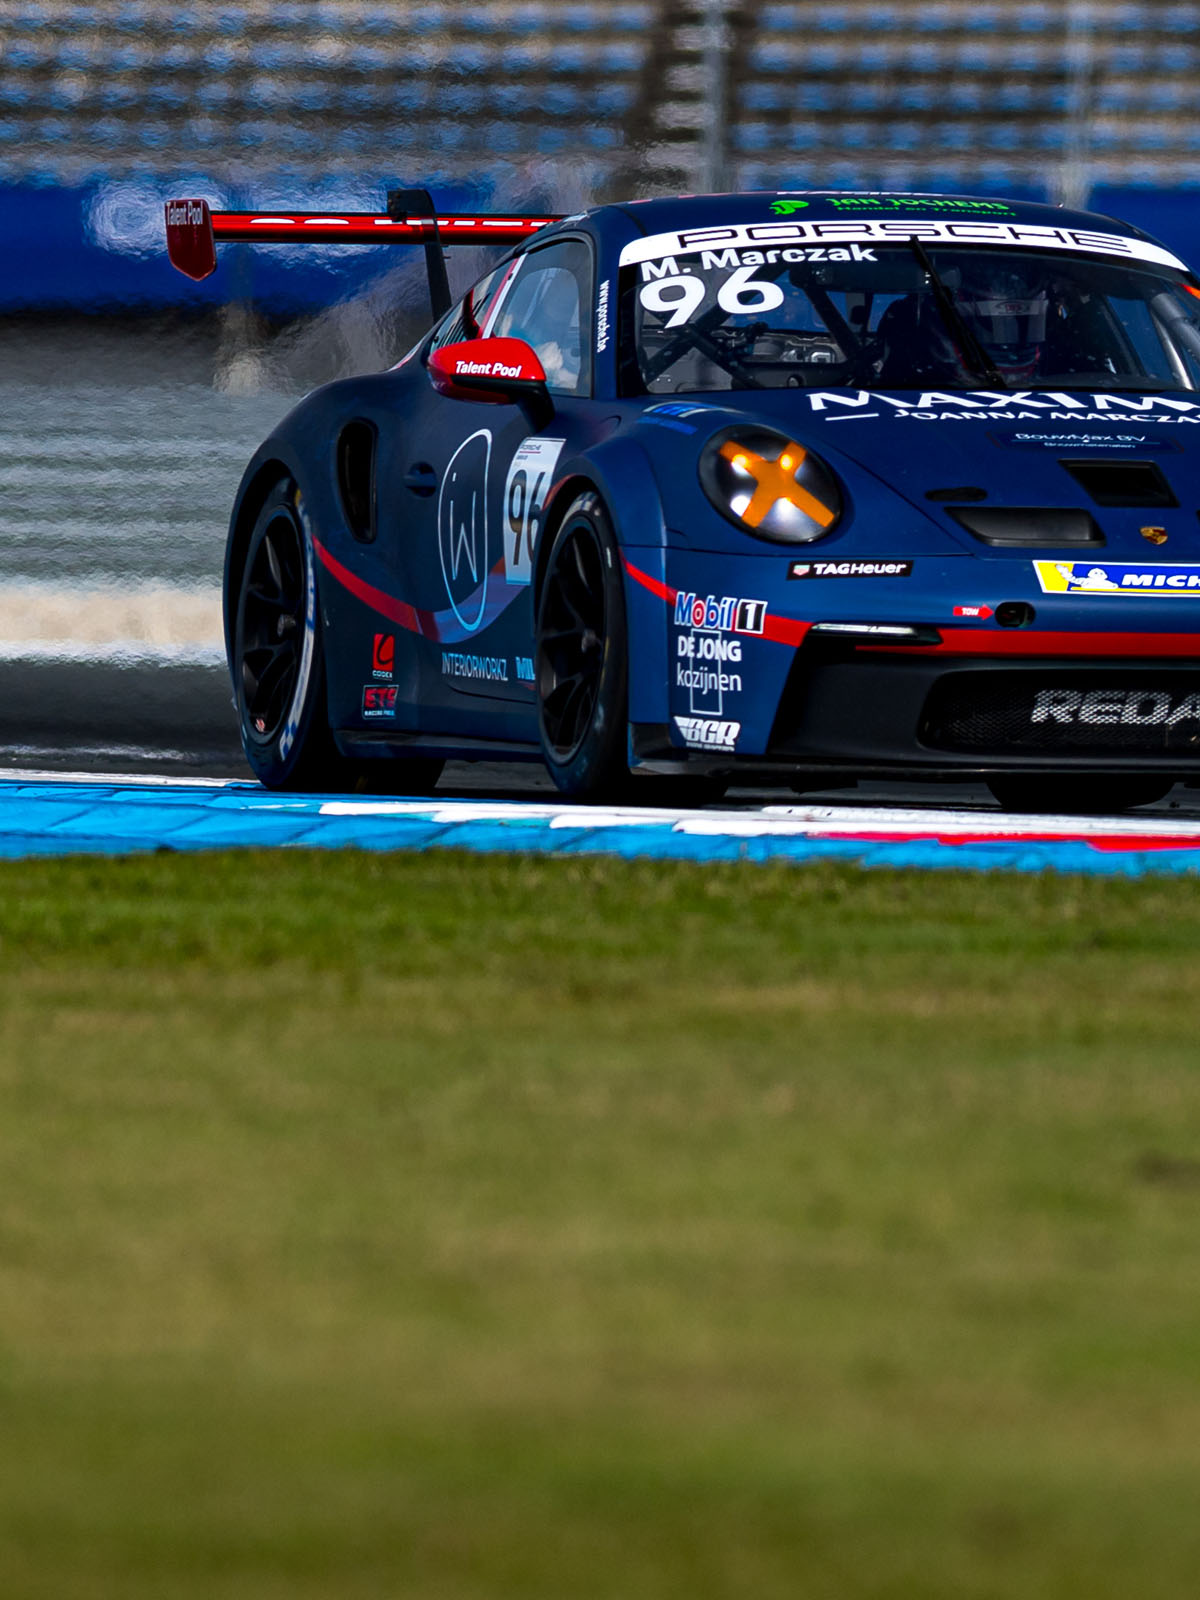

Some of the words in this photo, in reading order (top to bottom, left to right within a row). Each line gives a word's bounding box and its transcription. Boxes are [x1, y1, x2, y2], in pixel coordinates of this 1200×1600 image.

[676, 223, 1132, 253] PORSCHE
[640, 256, 692, 282] M.
[701, 244, 878, 271] Marczak
[639, 265, 785, 329] 96
[455, 360, 492, 375] Talent
[491, 362, 522, 377] Pool
[893, 408, 1042, 421] JOANNA
[674, 591, 737, 631] Mobil
[677, 635, 696, 657] DE
[696, 637, 742, 662] JONG
[441, 652, 509, 681] INTERIORWORKZ
[676, 661, 742, 695] kozijnen
[365, 687, 397, 708] ETS
